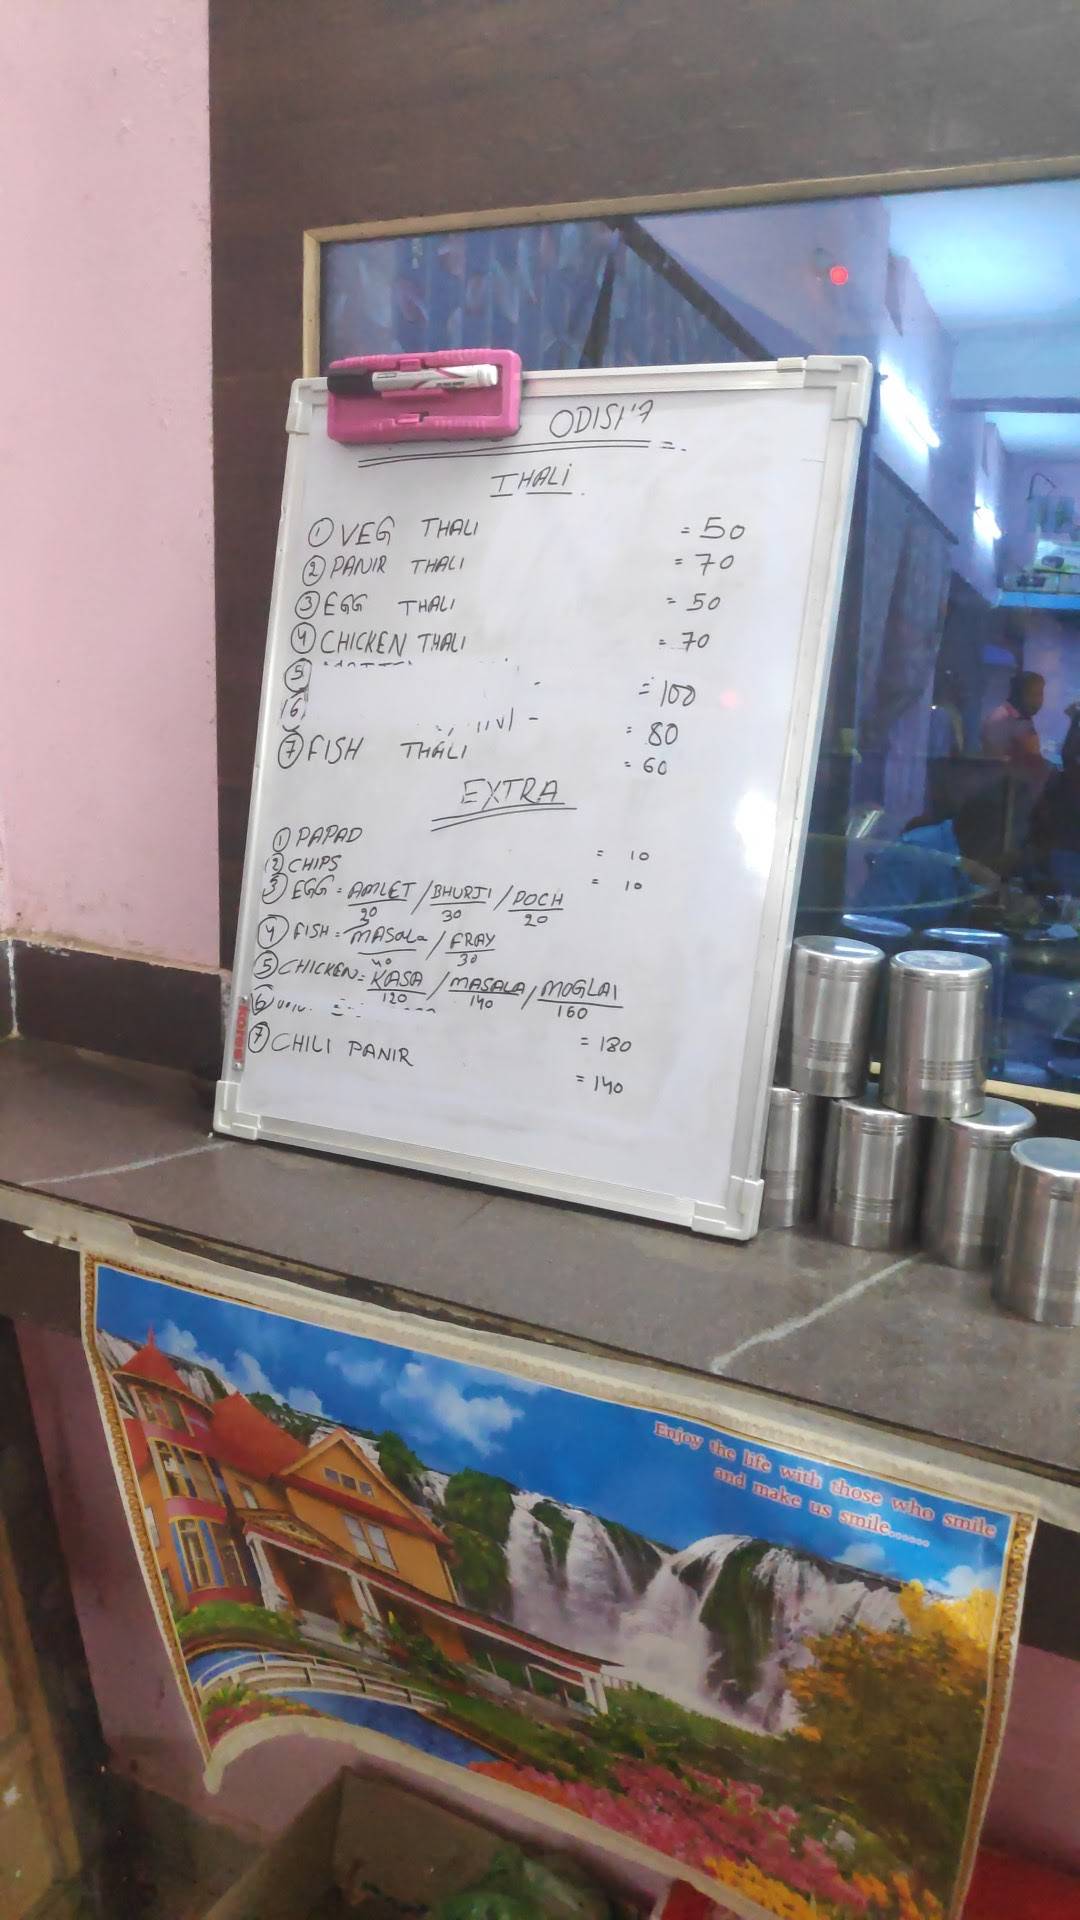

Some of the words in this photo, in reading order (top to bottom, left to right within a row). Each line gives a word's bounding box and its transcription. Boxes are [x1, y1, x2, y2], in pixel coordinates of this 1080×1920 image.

[342, 516, 395, 546] VEG
[422, 517, 478, 538] THALI
[700, 516, 745, 540] 50
[330, 556, 387, 578] PANIR
[411, 557, 464, 574] THALI
[695, 553, 734, 576] 70
[324, 591, 368, 616] EGG
[398, 596, 455, 616] THALI
[686, 593, 721, 611] 50
[321, 630, 407, 656] CHICKEN
[418, 631, 466, 653] THALI
[682, 631, 710, 651] 70
[660, 680, 696, 706] 100
[648, 722, 678, 746] 80
[308, 735, 364, 764] FISH
[400, 741, 467, 760] THALI
[643, 757, 667, 775] 60
[461, 777, 558, 811] EXTRA
[296, 824, 363, 847] PAPAD
[631, 850, 650, 861] 10
[288, 855, 342, 873] CHIPS
[625, 880, 642, 891] 10
[291, 874, 335, 900] EGG
[347, 880, 417, 899] AMLET
[431, 884, 492, 899] BHURJI
[442, 909, 462, 922] 30
[524, 914, 548, 927] 20
[294, 922, 329, 940] FISH
[450, 932, 496, 949] FRAY
[457, 953, 478, 967] 30
[278, 959, 358, 982] CHICKEN
[370, 969, 423, 990] KASA
[450, 977, 526, 995] MASALA
[541, 977, 618, 1001] MOGLAI
[382, 992, 408, 1005] 120
[470, 994, 494, 1010] 140
[558, 1005, 589, 1020] 160
[600, 1036, 632, 1052] 180
[271, 1033, 331, 1054] CHILI
[349, 1040, 415, 1067] PANIR
[594, 1075, 623, 1095] 140
[654, 1421, 703, 1450] Enjoy
[709, 1439, 736, 1462] the
[743, 1449, 772, 1474] life
[779, 1465, 823, 1490] with
[830, 1478, 883, 1506] those
[892, 1497, 936, 1521] who
[943, 1512, 997, 1538] smile
[713, 1466, 746, 1489] and
[752, 1481, 802, 1508] make
[809, 1500, 832, 1518] us
